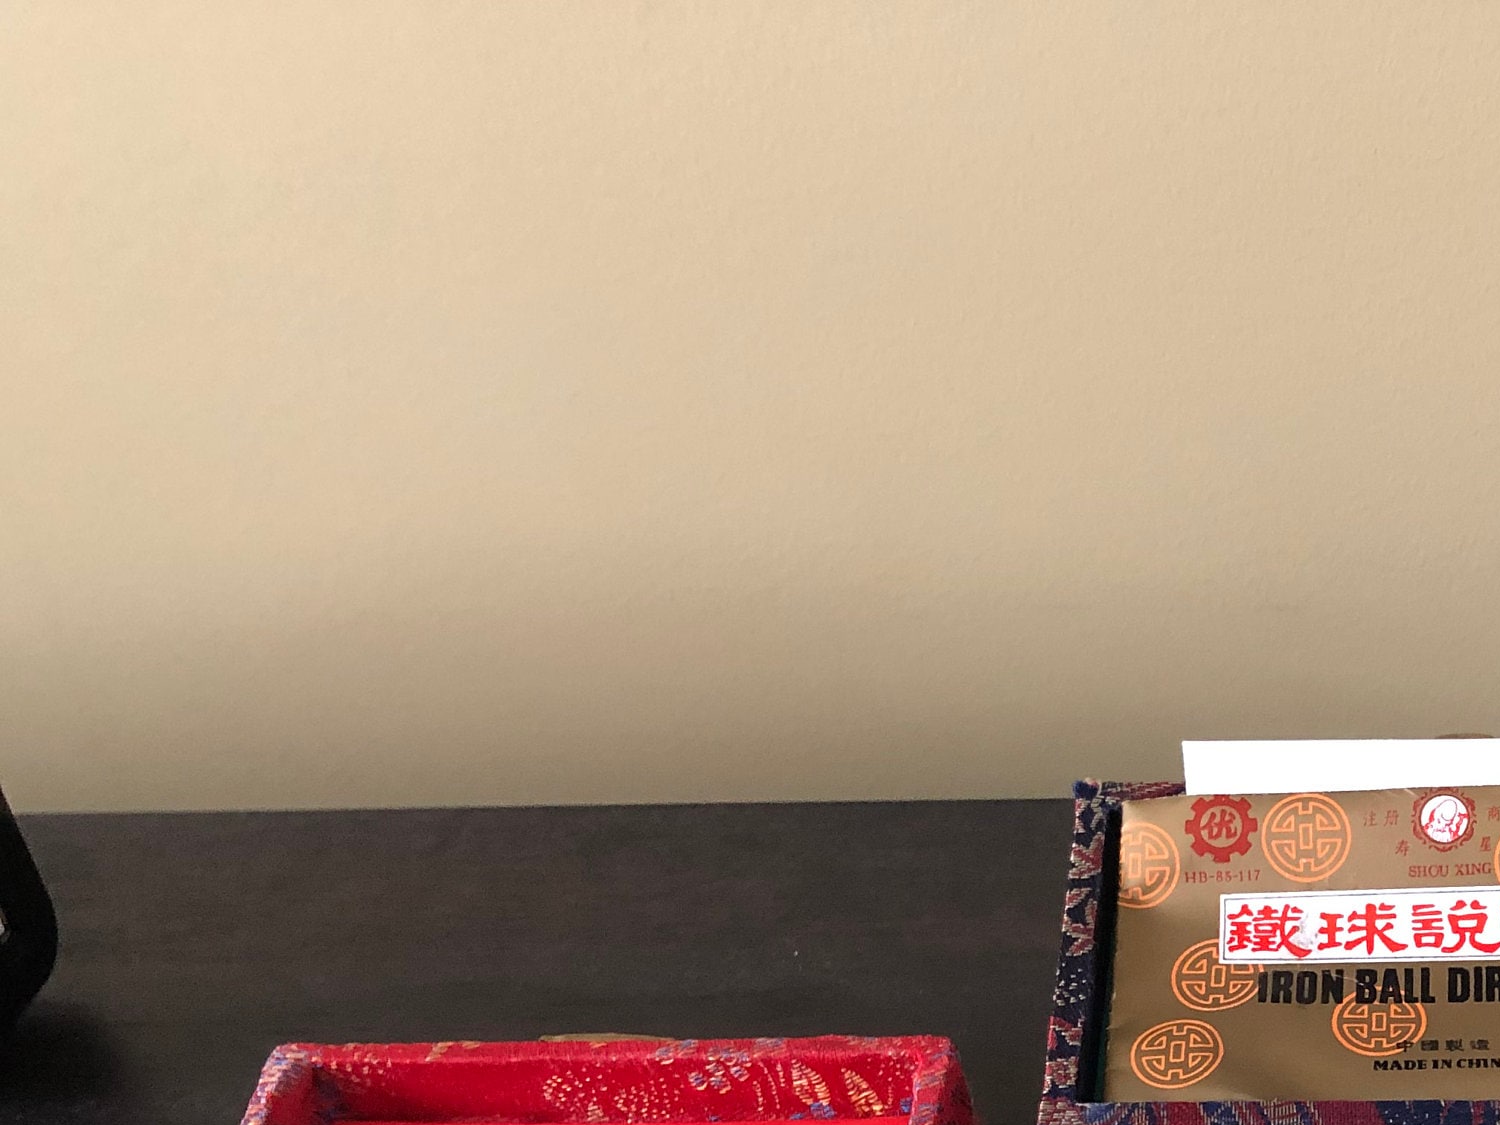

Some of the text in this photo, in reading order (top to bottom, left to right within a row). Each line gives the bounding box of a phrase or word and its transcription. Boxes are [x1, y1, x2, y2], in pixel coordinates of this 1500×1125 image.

[1408, 862, 1492, 877] SHOU XING
[1258, 969, 1344, 1004] IRON
[1356, 967, 1436, 1003] BALL
[1373, 1060, 1427, 1070] MADE
[1432, 1059, 1452, 1069] IN
